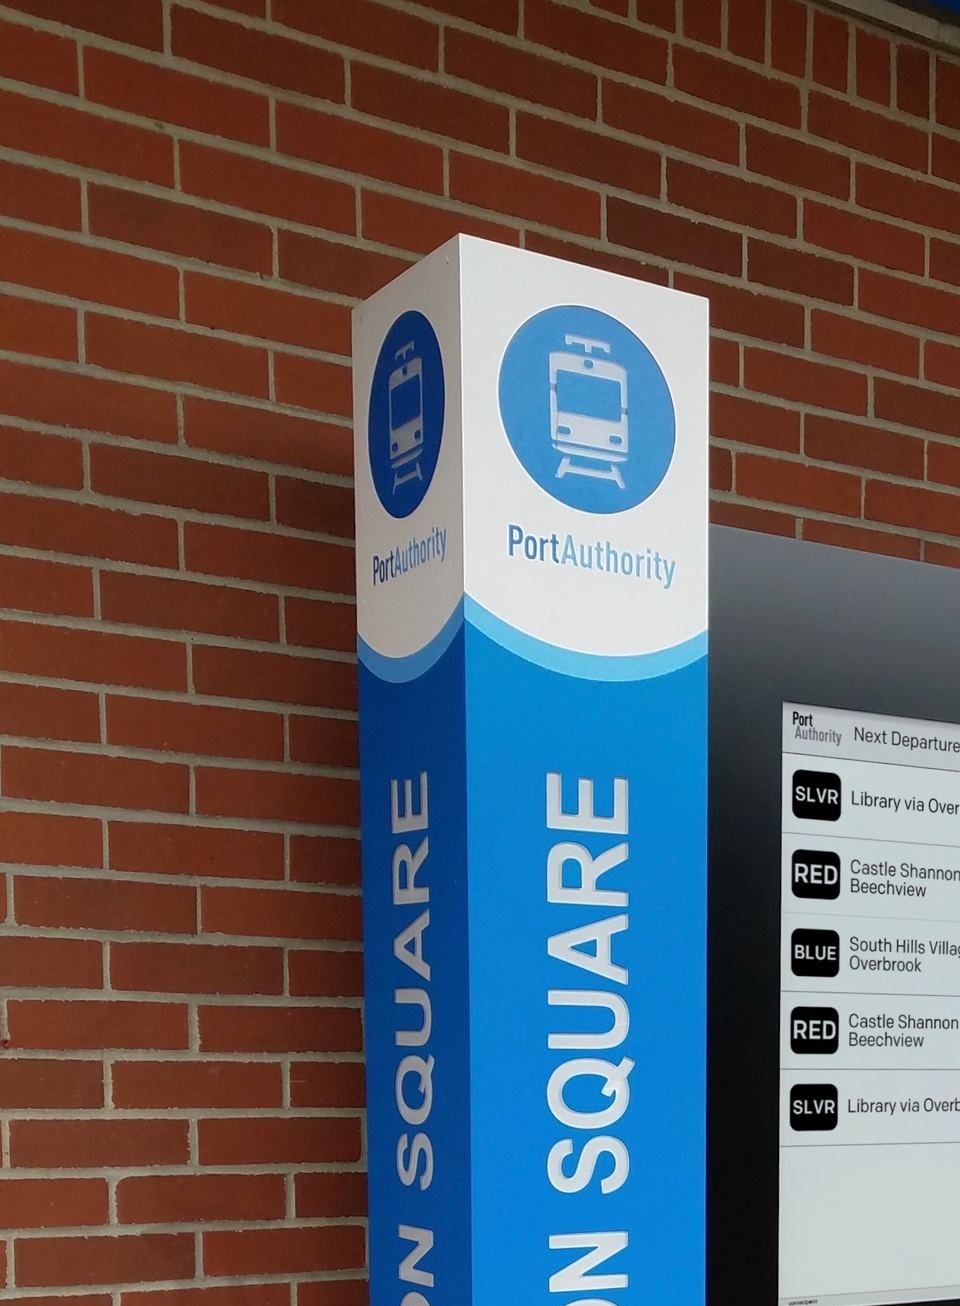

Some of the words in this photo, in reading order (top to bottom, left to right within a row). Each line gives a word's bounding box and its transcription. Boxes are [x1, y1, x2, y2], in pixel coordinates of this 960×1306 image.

[792, 711, 813, 727] Port
[794, 725, 842, 747] Authority
[854, 727, 887, 744] Next
[795, 786, 839, 805] SLVR
[851, 791, 901, 813] Library
[905, 797, 924, 812] via
[794, 863, 838, 885] RED
[850, 859, 897, 877] Castle
[900, 863, 960, 882] Shannon
[850, 878, 926, 897] Beechview
[794, 944, 837, 961] BLUE
[849, 936, 892, 953] South
[896, 939, 926, 954] Hills
[849, 955, 922, 972] Overbrook
[391, 771, 435, 1191] SQUARE
[546, 771, 636, 1194] SQUARE
[793, 1020, 837, 1040] RED
[849, 1013, 894, 1029] Castle
[898, 1014, 959, 1030] Shannon
[849, 1032, 924, 1047] Beechview
[792, 1100, 836, 1115] SLVR
[847, 1098, 896, 1115] Library
[900, 1099, 920, 1112] via
